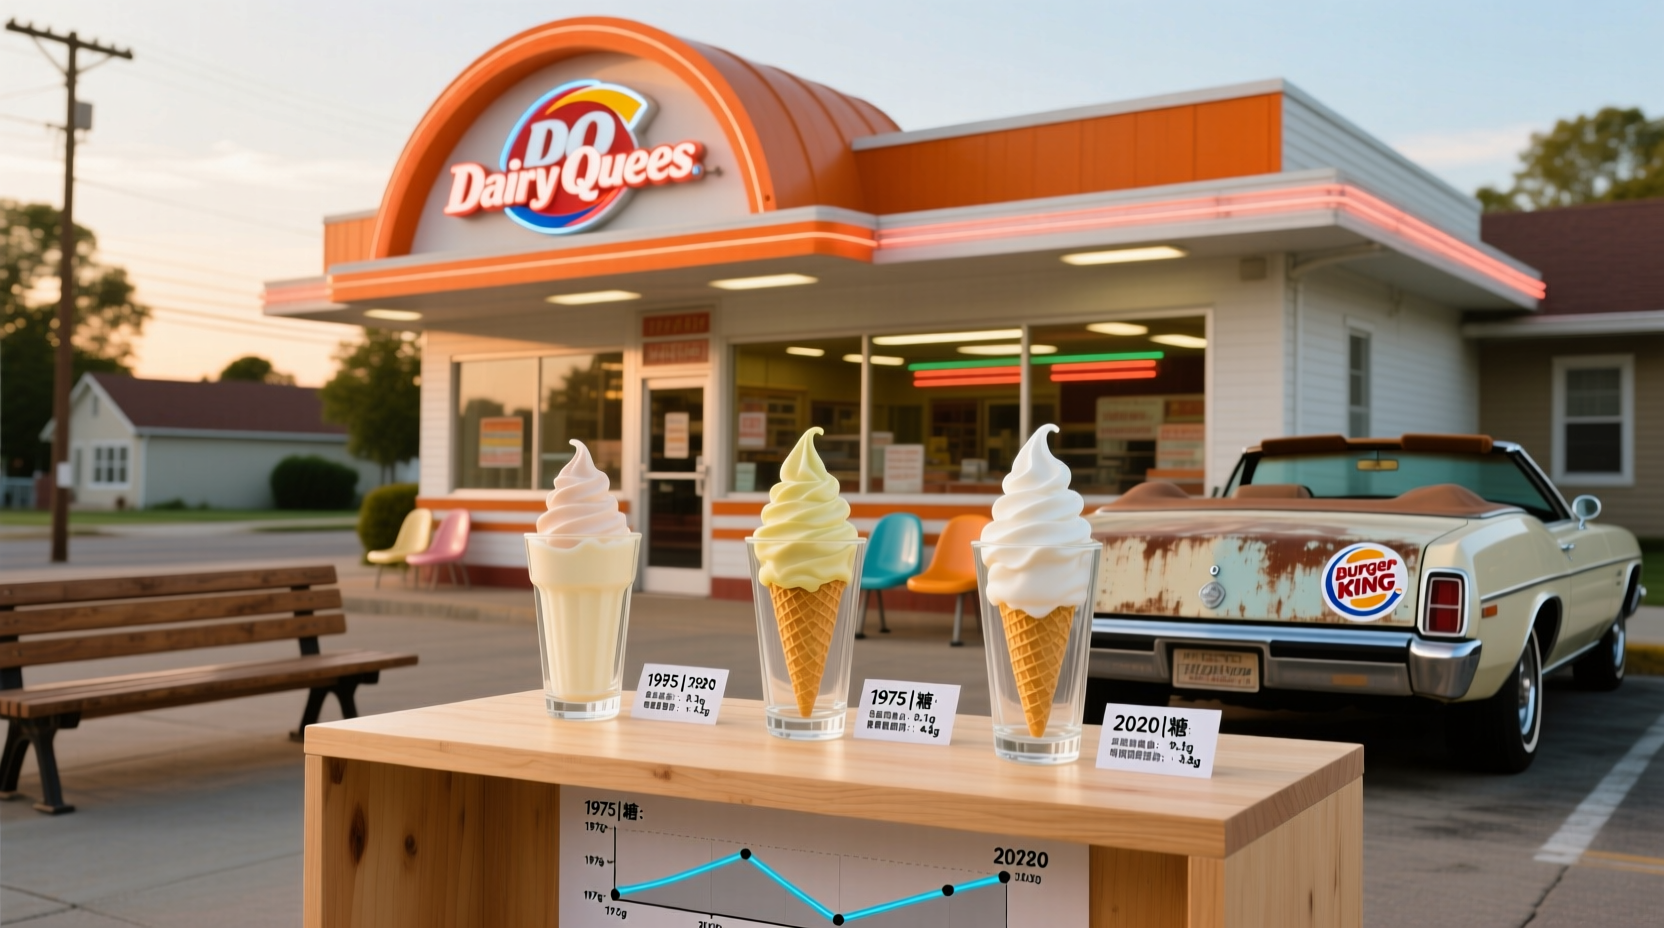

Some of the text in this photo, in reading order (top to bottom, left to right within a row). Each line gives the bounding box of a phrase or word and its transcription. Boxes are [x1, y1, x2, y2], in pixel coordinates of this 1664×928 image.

[443, 158, 561, 216] Dairy
[1335, 558, 1398, 582] Burger
[1337, 572, 1396, 600] KING
